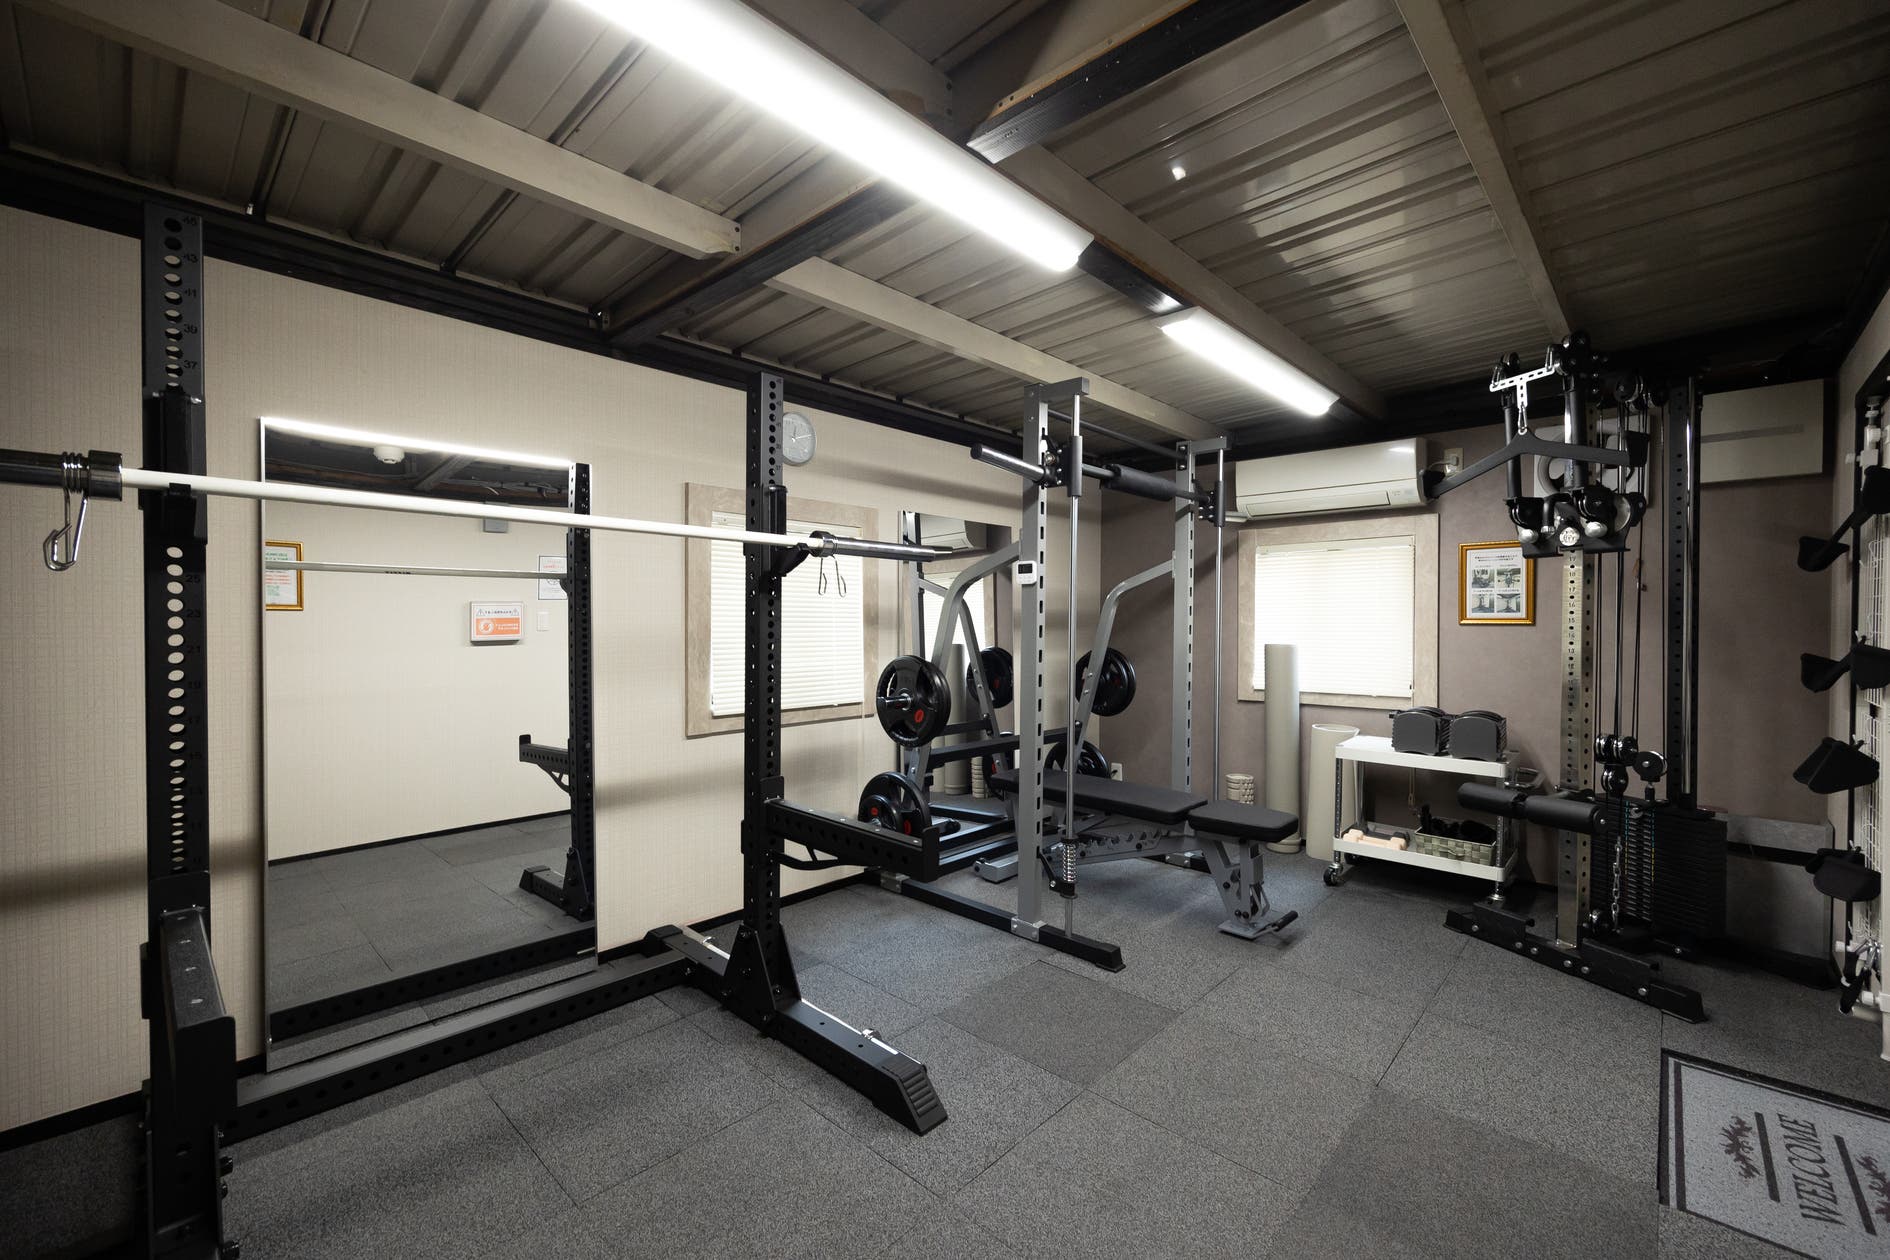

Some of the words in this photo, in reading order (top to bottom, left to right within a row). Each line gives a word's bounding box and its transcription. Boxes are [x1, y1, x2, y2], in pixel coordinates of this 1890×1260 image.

[184, 360, 198, 370] 37
[186, 575, 200, 583] 25
[187, 610, 201, 618] 23
[1777, 1113, 1846, 1226] WELCOME
